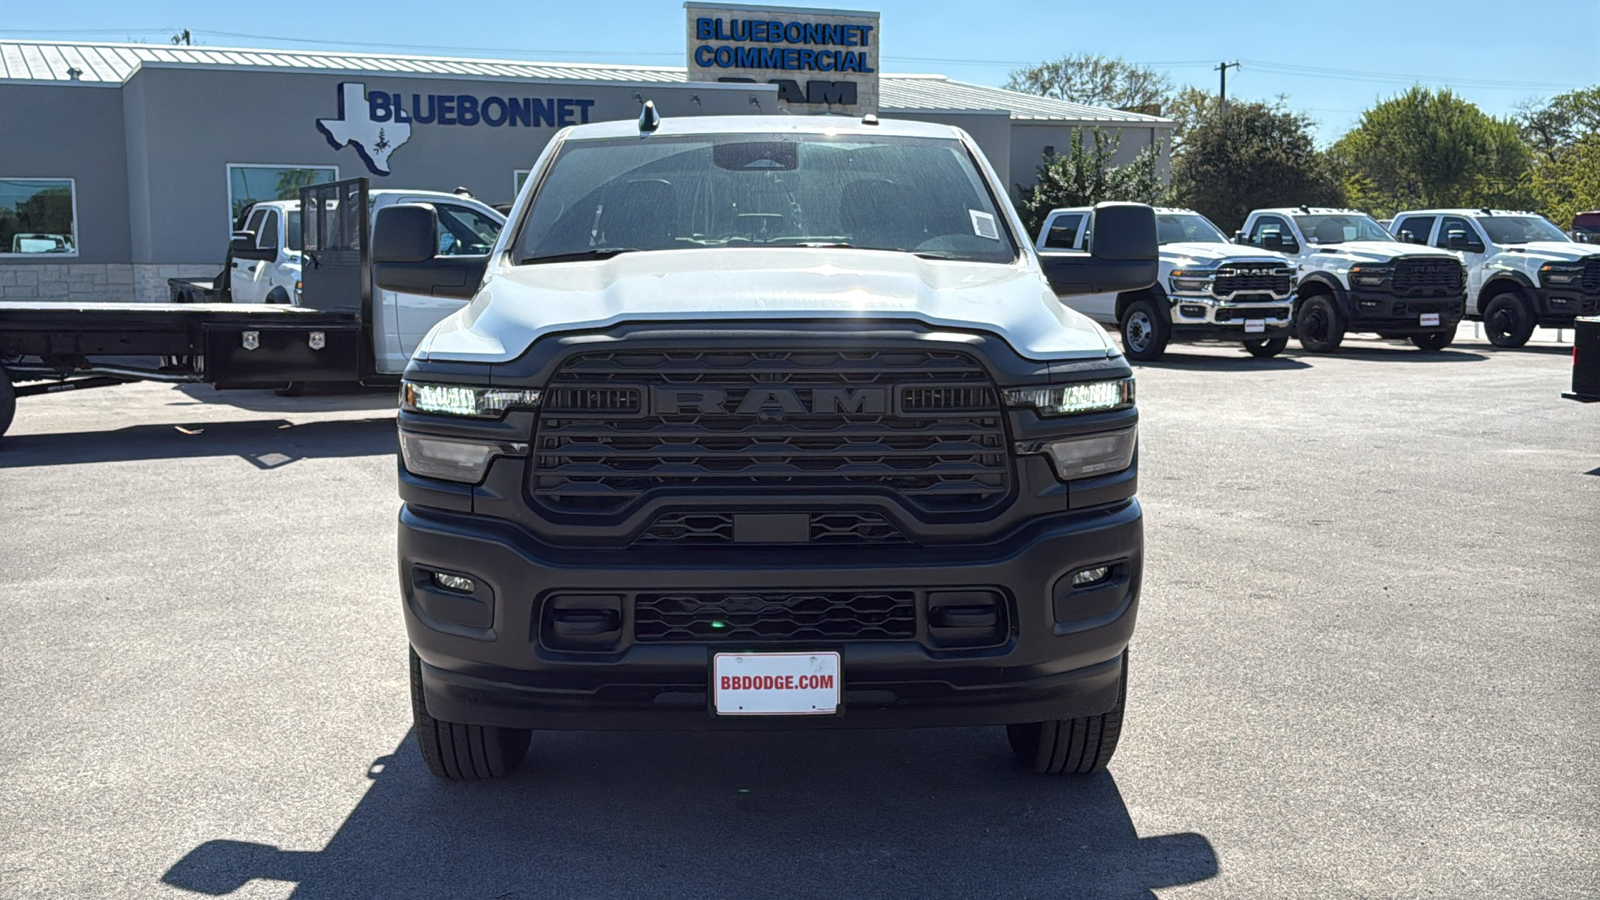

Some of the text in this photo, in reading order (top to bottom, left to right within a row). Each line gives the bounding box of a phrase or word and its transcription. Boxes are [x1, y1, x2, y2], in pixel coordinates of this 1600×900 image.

[696, 18, 873, 46] BLUEBONNET
[694, 45, 874, 73] COMMERCIAL
[368, 91, 595, 127] BLUEBONNET
[656, 387, 888, 414] RAM
[721, 675, 833, 690] BBDODGE.COM
